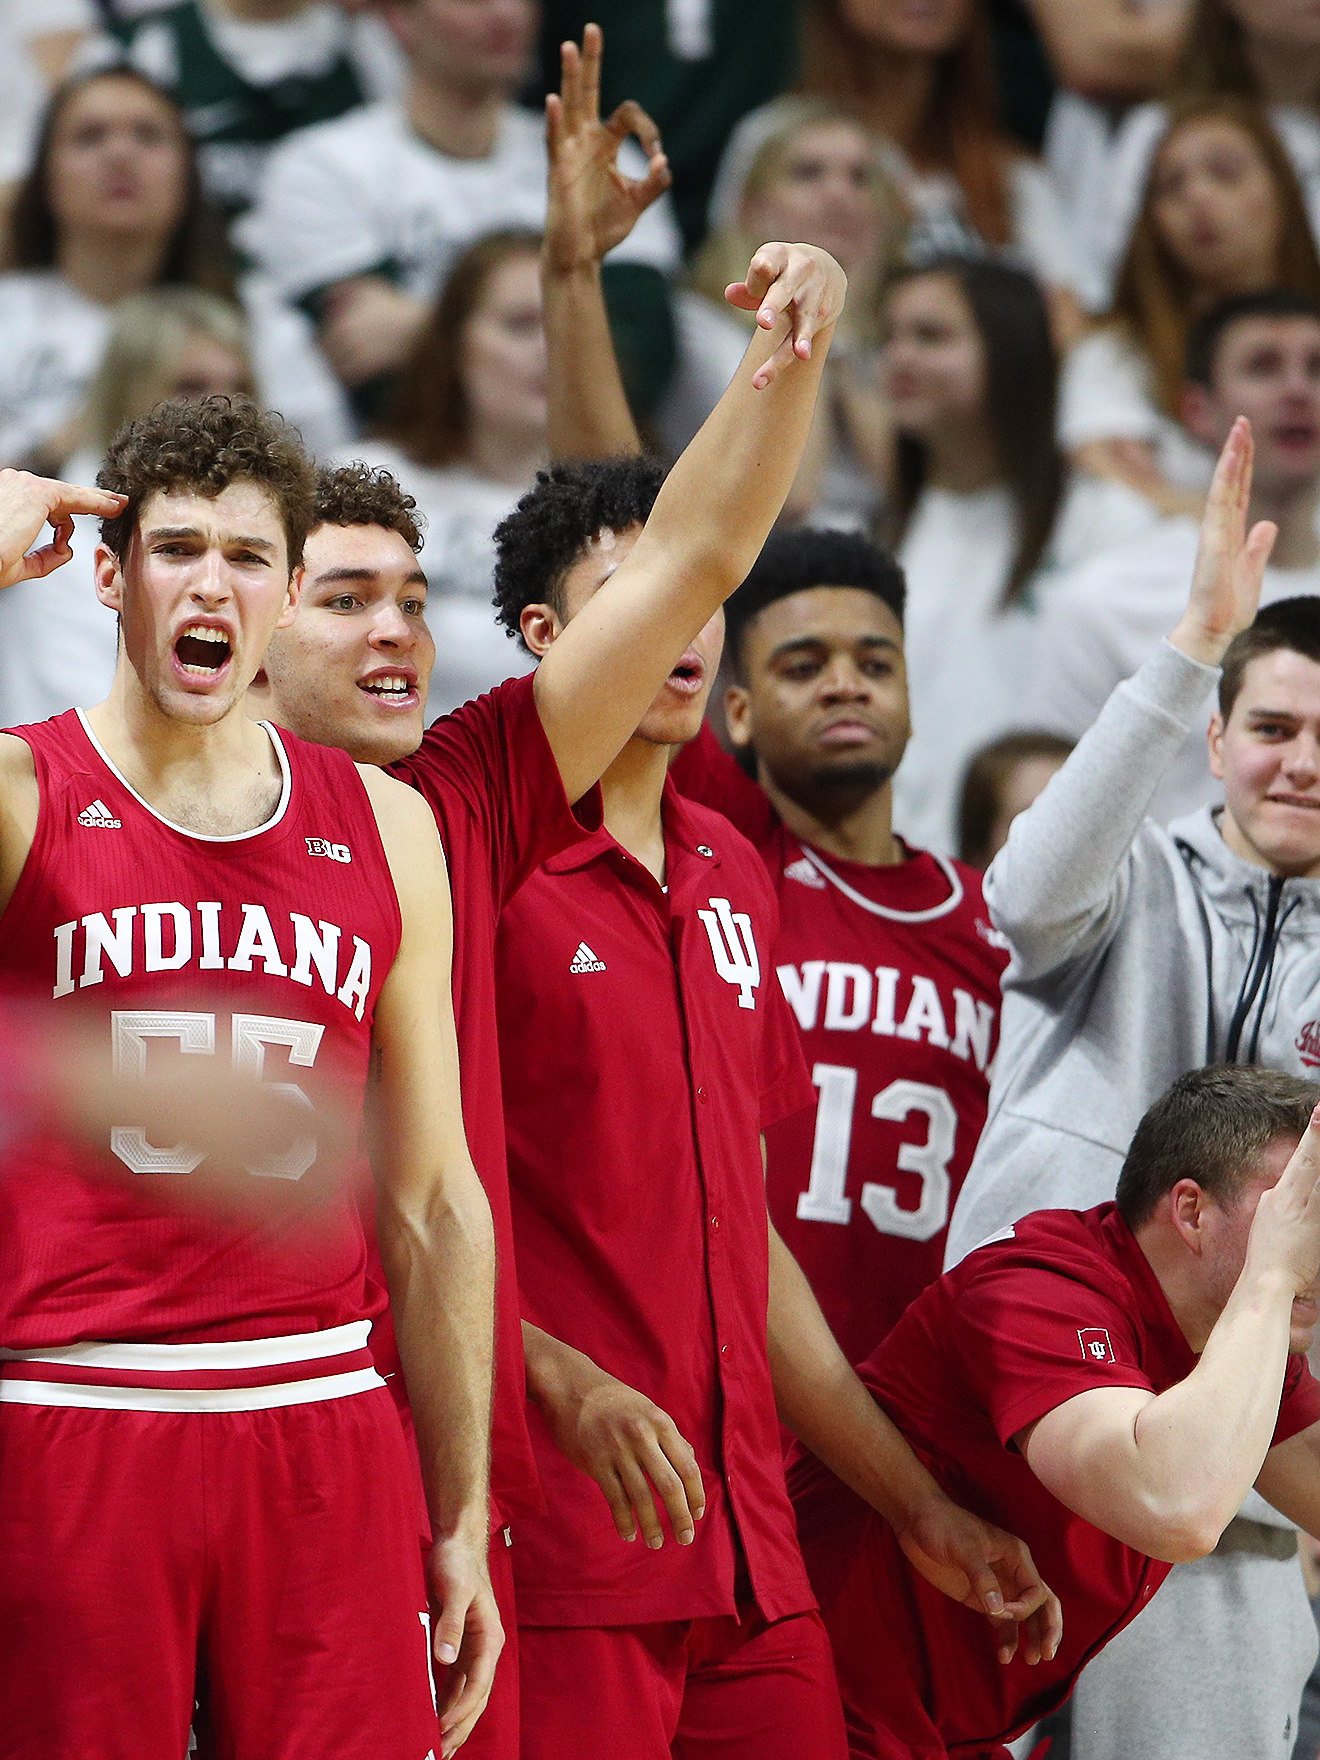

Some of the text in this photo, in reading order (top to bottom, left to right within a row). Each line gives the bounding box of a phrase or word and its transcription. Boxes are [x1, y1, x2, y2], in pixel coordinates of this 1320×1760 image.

[77, 816, 122, 829] adidas
[53, 901, 372, 1022] INDIANA
[569, 960, 607, 974] adidas
[776, 960, 996, 1070] NDIAN
[797, 1063, 958, 1241] 13
